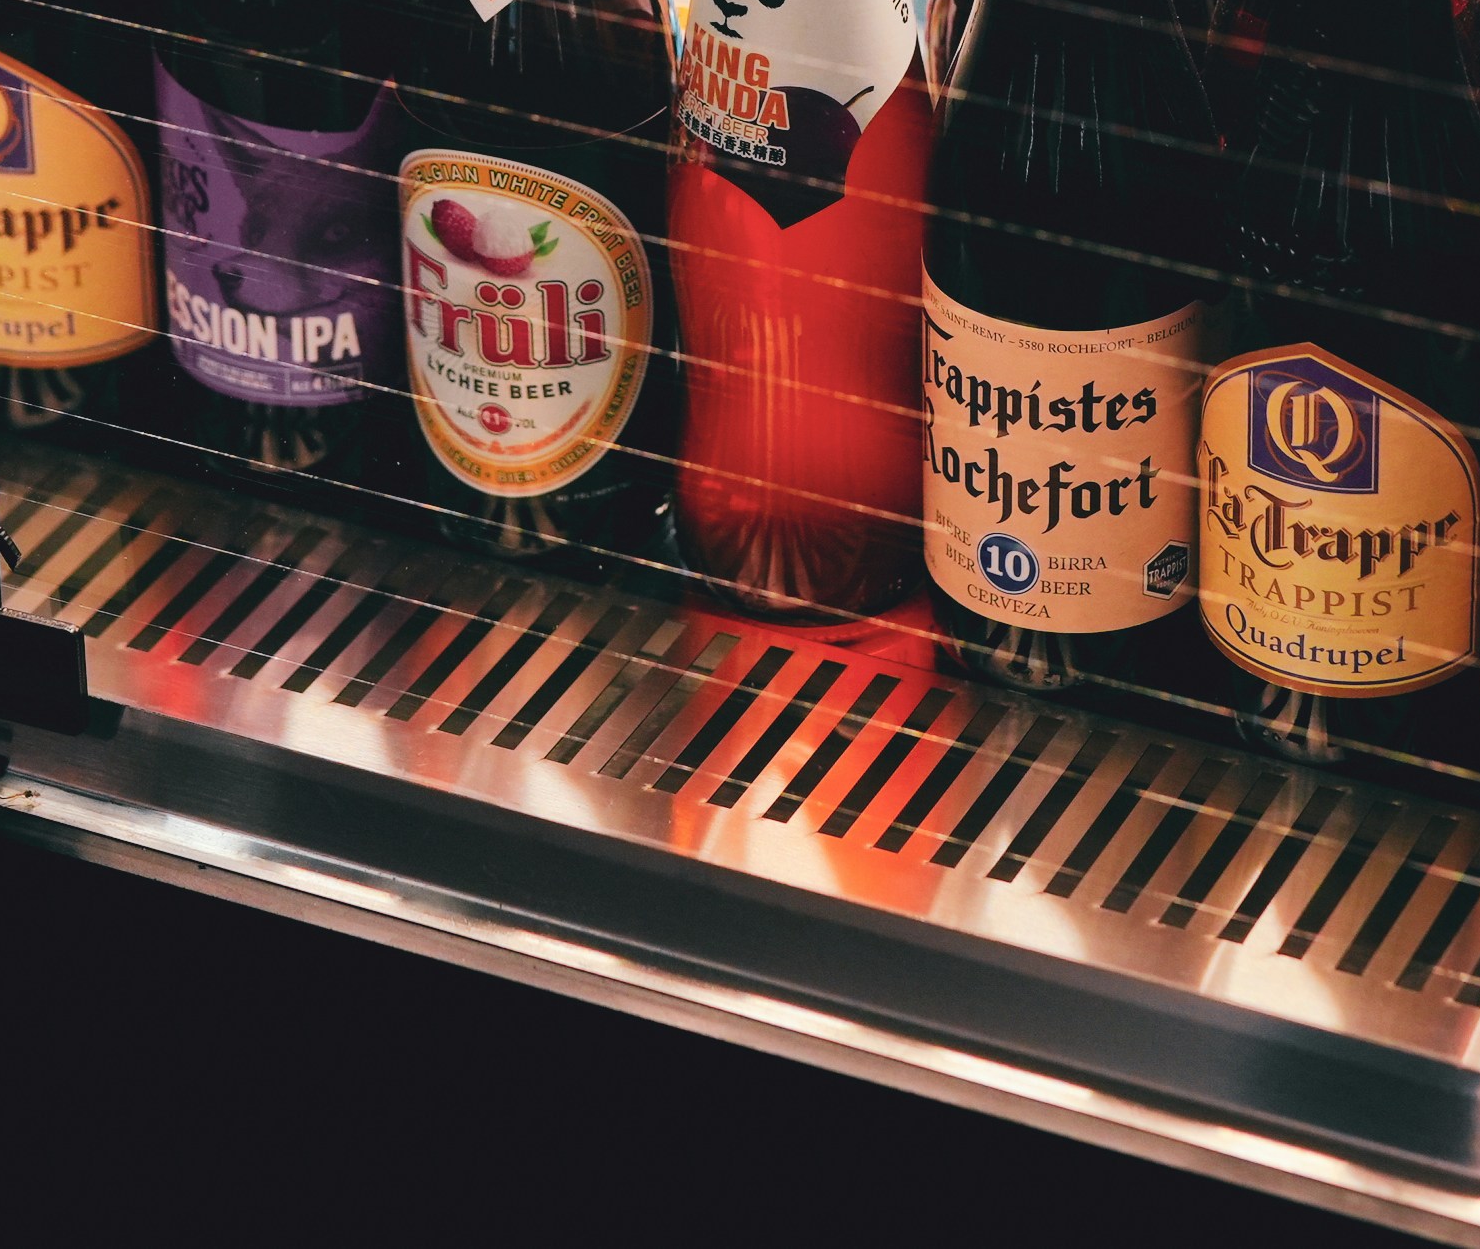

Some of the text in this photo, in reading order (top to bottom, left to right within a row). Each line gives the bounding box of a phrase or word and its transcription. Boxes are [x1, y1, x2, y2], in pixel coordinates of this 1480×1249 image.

[692, 22, 770, 88] KING
[681, 48, 790, 129] PANDA
[684, 91, 768, 143] CRAFT BEER
[411, 162, 643, 310] ELGIAN WHITE FRUIT BEER
[406, 236, 612, 370] Früli
[940, 304, 1006, 343] SAINT-REMY
[1019, 339, 1044, 352] 5580
[1048, 337, 1135, 354] ROCHEFORT
[1147, 313, 1196, 344] BELGIUM
[292, 313, 361, 363] IPA
[427, 353, 573, 400] LYCHEE BEER
[462, 361, 523, 382] PREMIUM
[923, 307, 1158, 439] Trappistes
[1266, 381, 1355, 483] Q
[923, 385, 1162, 536] Rochefort
[1204, 439, 1461, 581] La Trappe
[946, 542, 976, 574] BIER
[986, 544, 1032, 582] 10
[1047, 556, 1108, 571] BIRRA
[1149, 556, 1187, 584] TRAPPIST
[1219, 544, 1425, 617] TRAPPIST
[967, 583, 1052, 619] CERVEZA
[1040, 579, 1092, 597] BEER
[1225, 603, 1407, 674] Quadrupel
